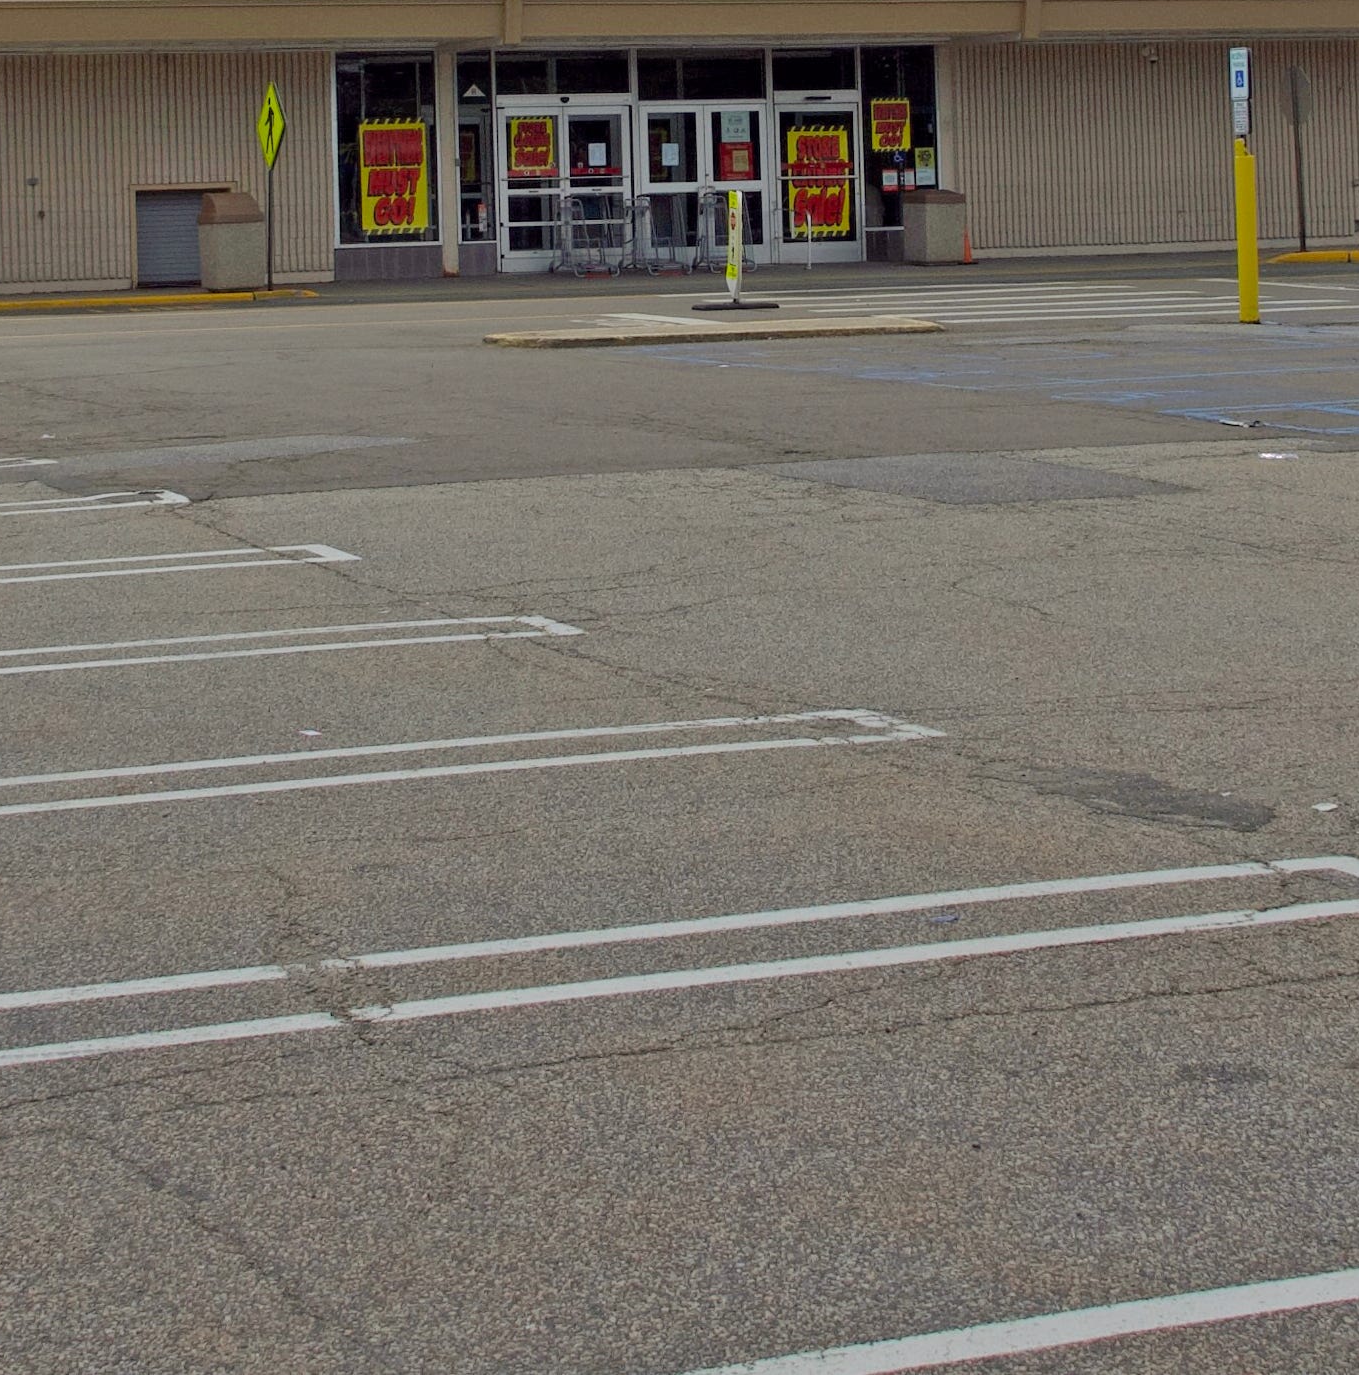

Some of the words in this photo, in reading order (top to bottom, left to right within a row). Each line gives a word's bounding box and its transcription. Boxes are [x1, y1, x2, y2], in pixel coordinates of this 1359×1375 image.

[796, 134, 840, 160] STORE
[367, 168, 421, 197] MUST
[374, 196, 416, 226] GO!
[794, 187, 845, 227] Sale!
